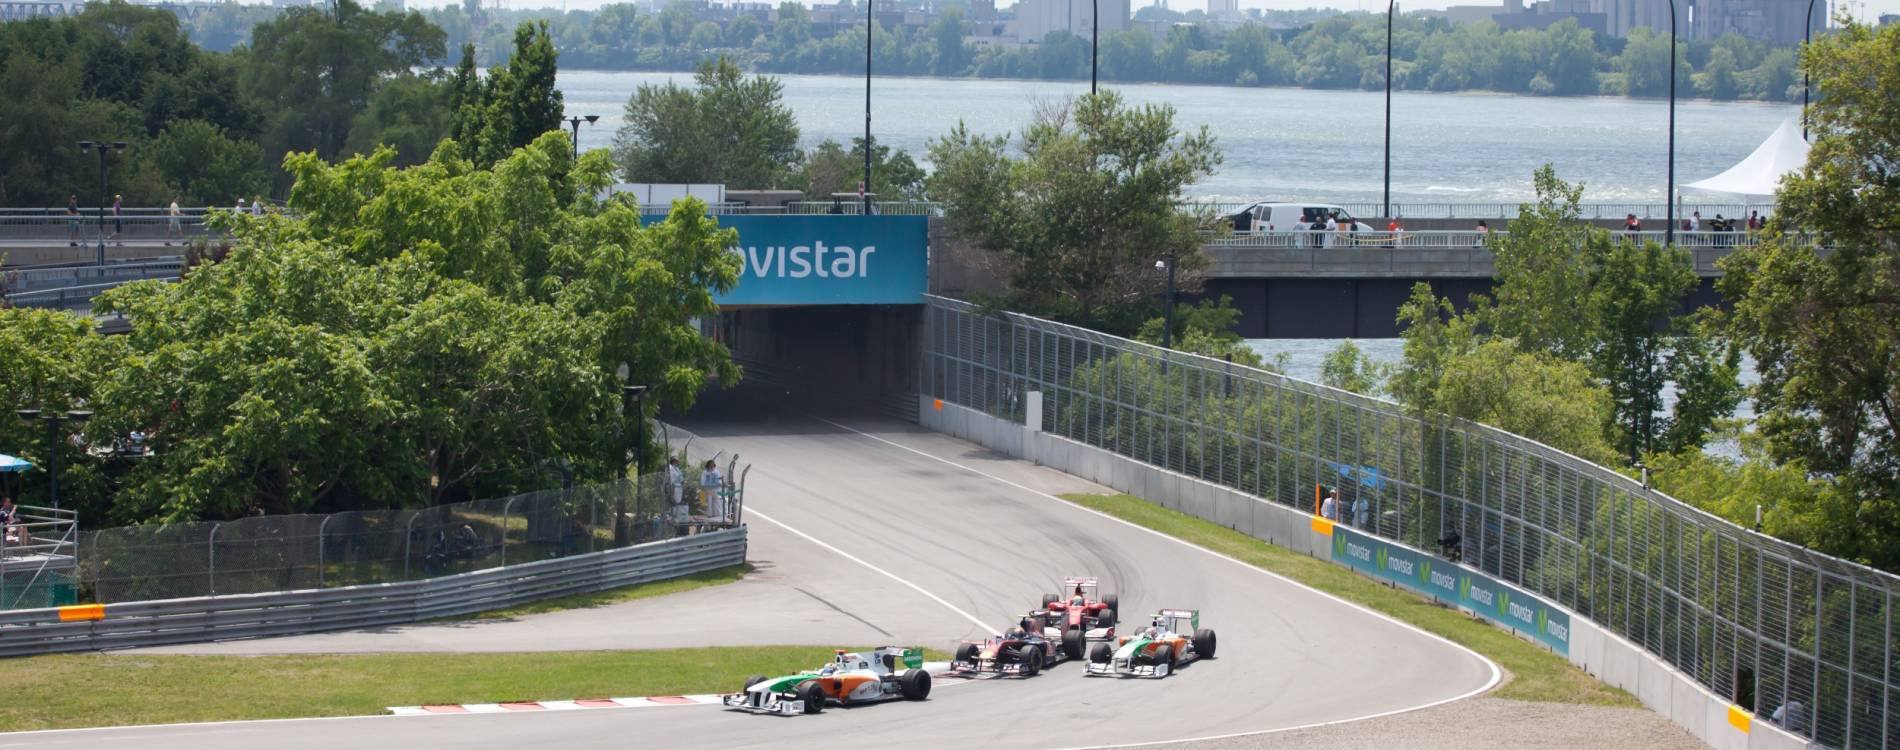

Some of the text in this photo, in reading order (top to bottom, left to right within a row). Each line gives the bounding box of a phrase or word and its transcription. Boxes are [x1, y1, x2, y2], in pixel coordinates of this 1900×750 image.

[729, 240, 876, 278] vistar
[1346, 542, 1371, 561] movistar
[1388, 555, 1414, 576] movistar
[1431, 570, 1456, 591] movistar
[1471, 585, 1493, 606] movistar
[1509, 601, 1534, 624] movistar
[1547, 618, 1568, 641] movistar
